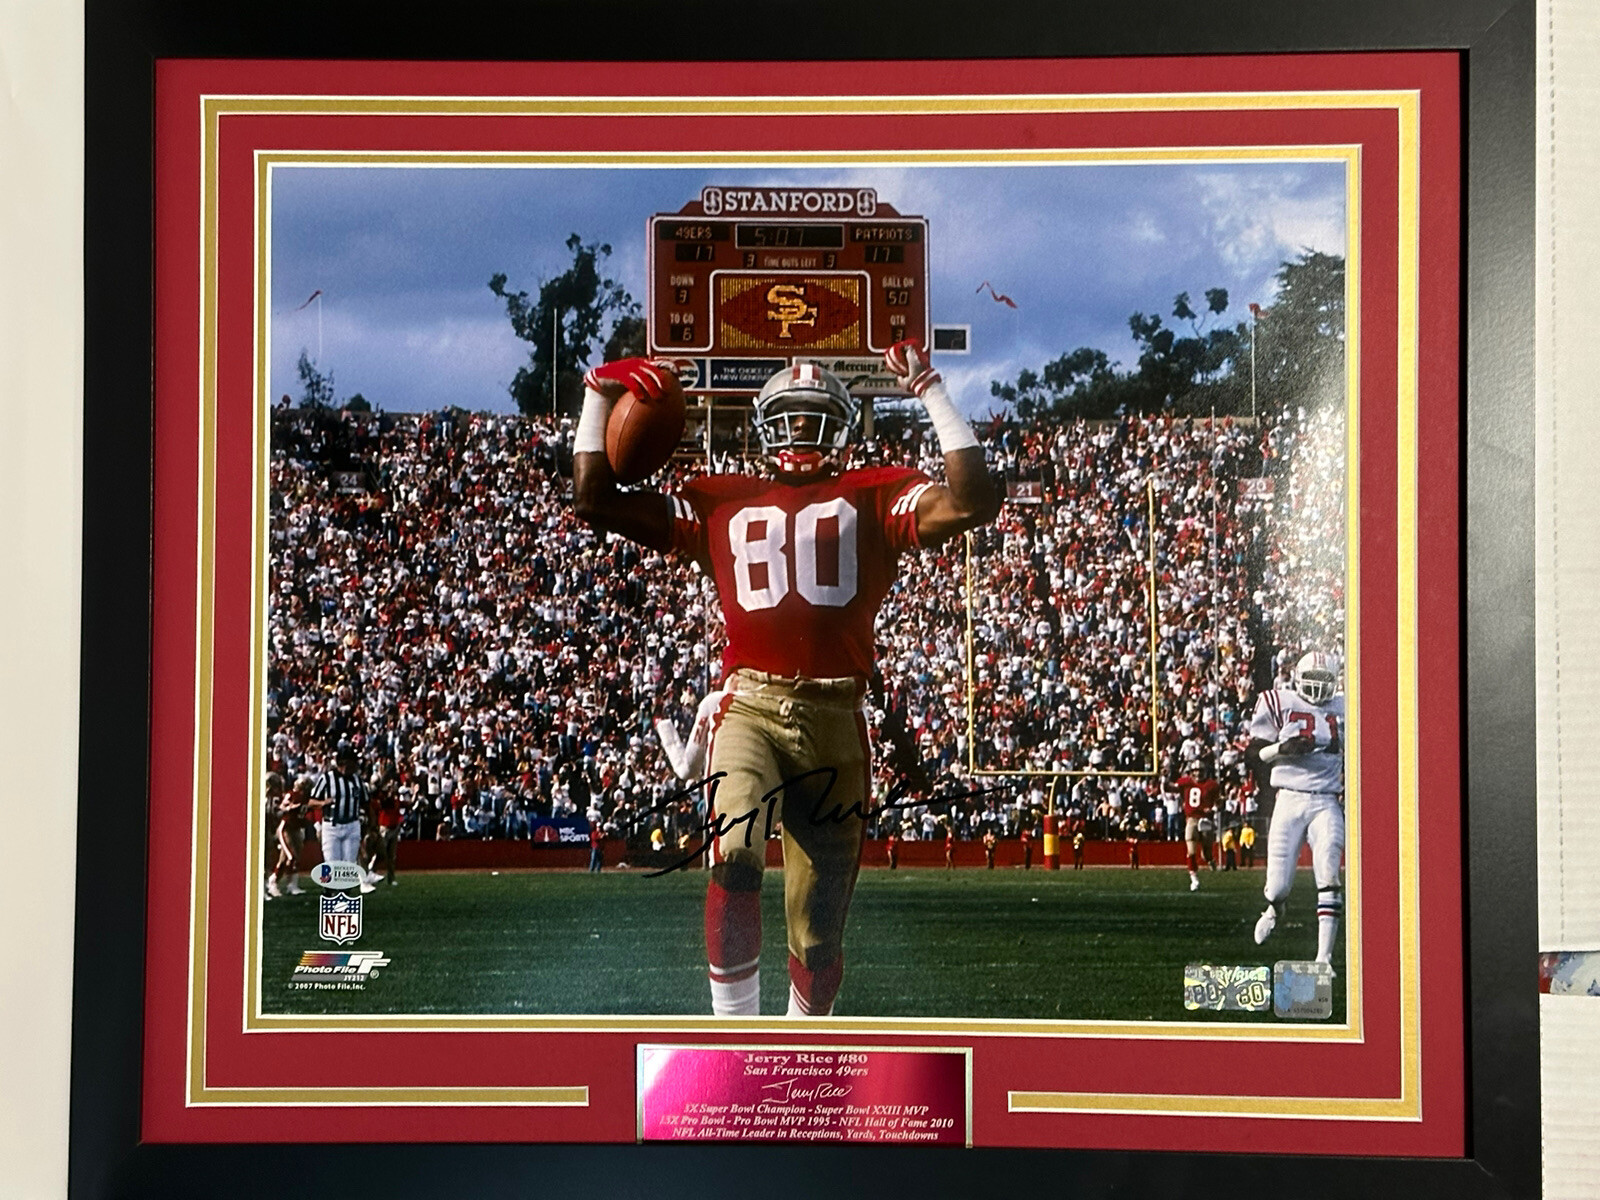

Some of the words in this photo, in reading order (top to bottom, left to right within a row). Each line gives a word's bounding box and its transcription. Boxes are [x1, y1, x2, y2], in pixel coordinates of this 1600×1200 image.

[725, 192, 854, 212] STANFORD
[675, 227, 712, 239] 49ERS
[855, 228, 913, 240] PATRIOTS
[696, 246, 713, 260] 17
[873, 247, 890, 262] 17
[747, 254, 755, 267] 3
[764, 257, 779, 267] TIME
[801, 257, 817, 268] LEFT
[827, 255, 835, 268] 3
[670, 276, 694, 286] DOWN
[882, 277, 901, 288] BALL
[903, 277, 914, 288] ON
[889, 291, 908, 305] 50
[670, 313, 680, 324] TO
[683, 313, 694, 324] GO
[890, 315, 906, 325] QTR
[683, 327, 692, 341] 6
[833, 360, 878, 374] Mercury
[340, 474, 357, 486] 24
[1017, 484, 1033, 496] 21
[728, 497, 858, 612] 80
[1189, 787, 1201, 808] 8
[560, 834, 590, 842] SPORTS
[324, 914, 357, 937] NFL
[294, 966, 333, 974] Photo
[333, 966, 357, 974] File
[744, 1054, 790, 1065] Jerry
[796, 1054, 833, 1064] Rice
[838, 1054, 868, 1064] #80
[744, 1065, 767, 1075] San
[772, 1065, 832, 1076] Francisco
[836, 1066, 869, 1076] 49ers
[700, 1104, 728, 1115] Super
[731, 1104, 754, 1114] Bowl
[757, 1104, 806, 1116] Champion
[814, 1105, 843, 1116] Super
[846, 1105, 870, 1115] Bowl
[872, 1105, 901, 1115] XXIII
[903, 1106, 929, 1116] MVP
[680, 1116, 698, 1125] Pro
[701, 1116, 725, 1126] Bowl
[733, 1116, 751, 1126] Pro
[753, 1116, 777, 1126] Bowl
[780, 1117, 806, 1126] MVP
[807, 1117, 830, 1126] 1995
[839, 1117, 862, 1127] NFL
[865, 1117, 885, 1127] Hall
[888, 1118, 899, 1129] of
[901, 1118, 927, 1128] Fame
[930, 1118, 954, 1128] 2010
[672, 1128, 695, 1137] NFL
[698, 1128, 739, 1138] All-Time
[742, 1128, 775, 1138] Leader
[778, 1128, 786, 1138] in
[789, 1129, 844, 1140] Receptions,
[846, 1129, 876, 1140] Yards,
[879, 1130, 939, 1140] Touchdowns
